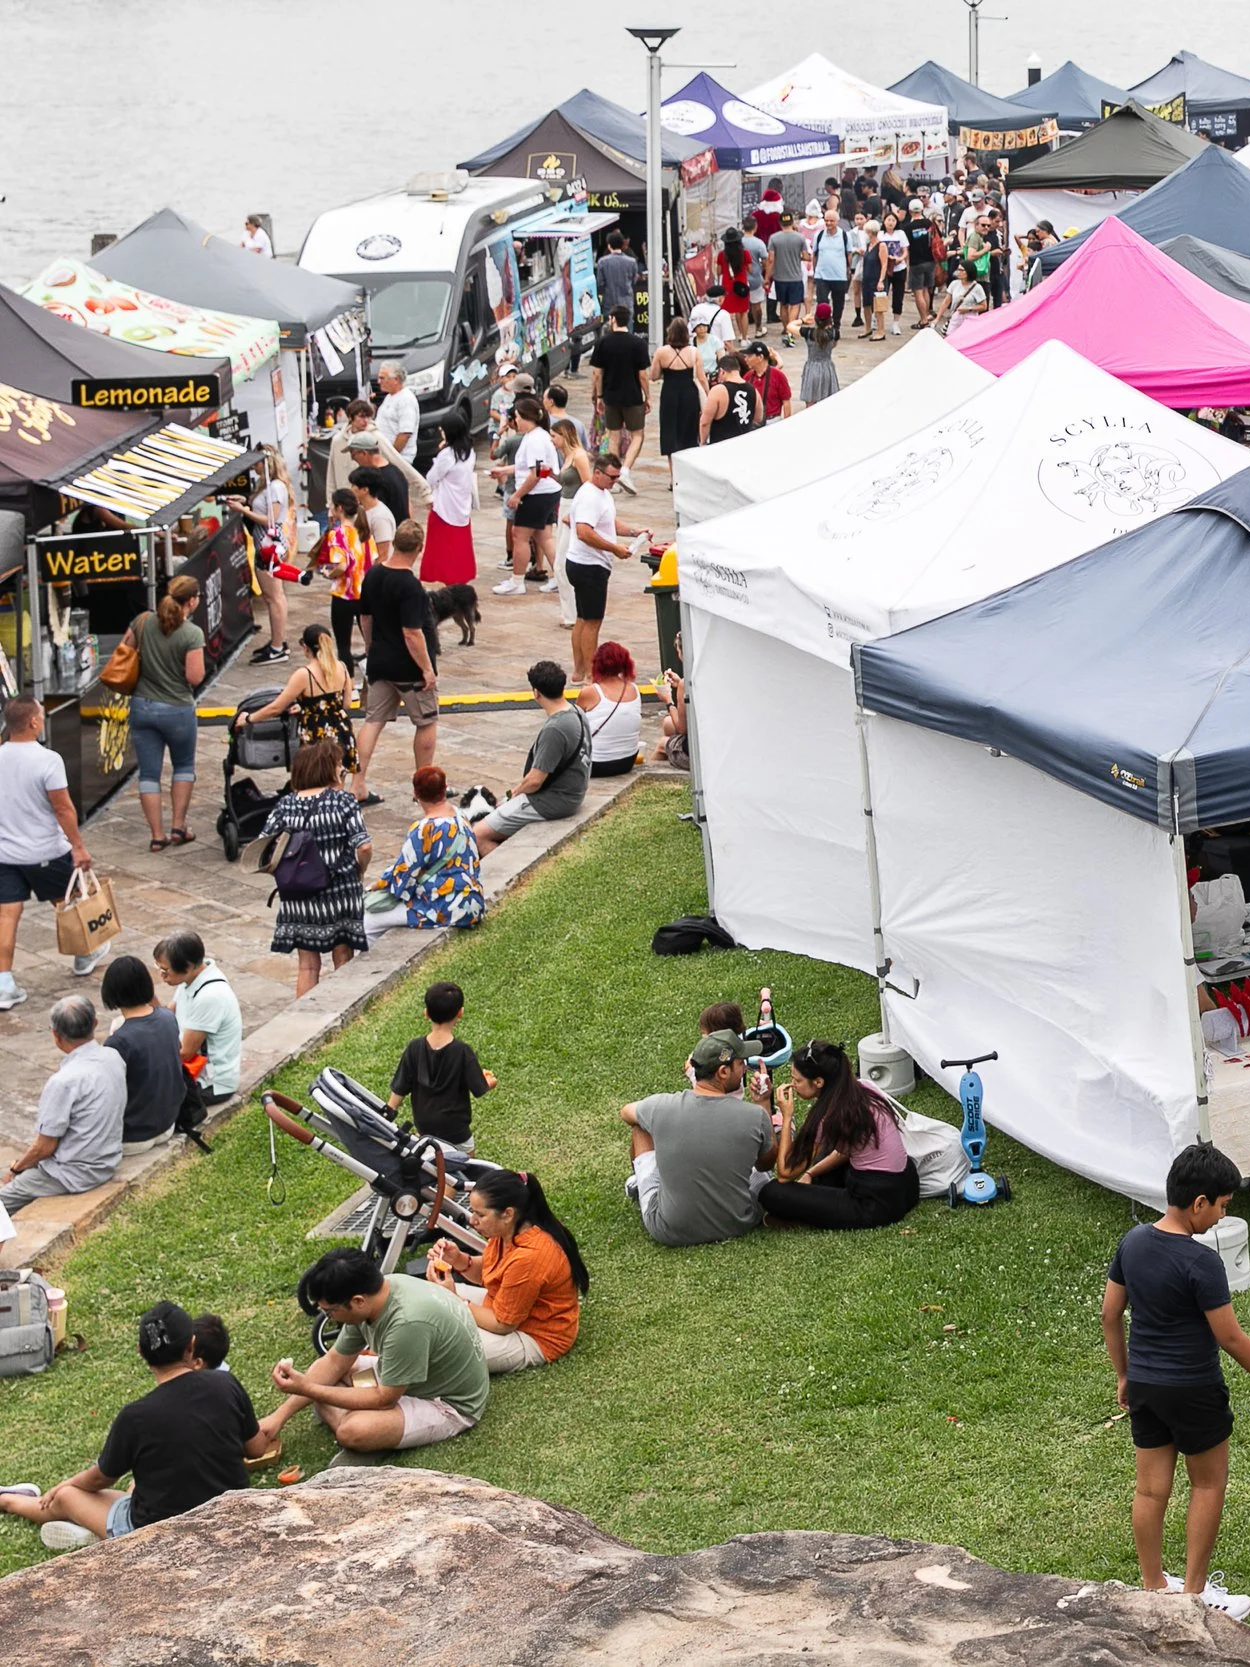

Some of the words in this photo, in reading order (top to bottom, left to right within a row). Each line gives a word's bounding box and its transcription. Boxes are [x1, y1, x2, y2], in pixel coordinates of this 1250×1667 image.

[80, 380, 210, 407] Lemonade
[1049, 415, 1153, 448] SCYLLA
[46, 548, 137, 576] Water
[710, 561, 748, 589] SCYLLA
[87, 908, 113, 933] DOG
[966, 1097, 974, 1133] SCOOT
